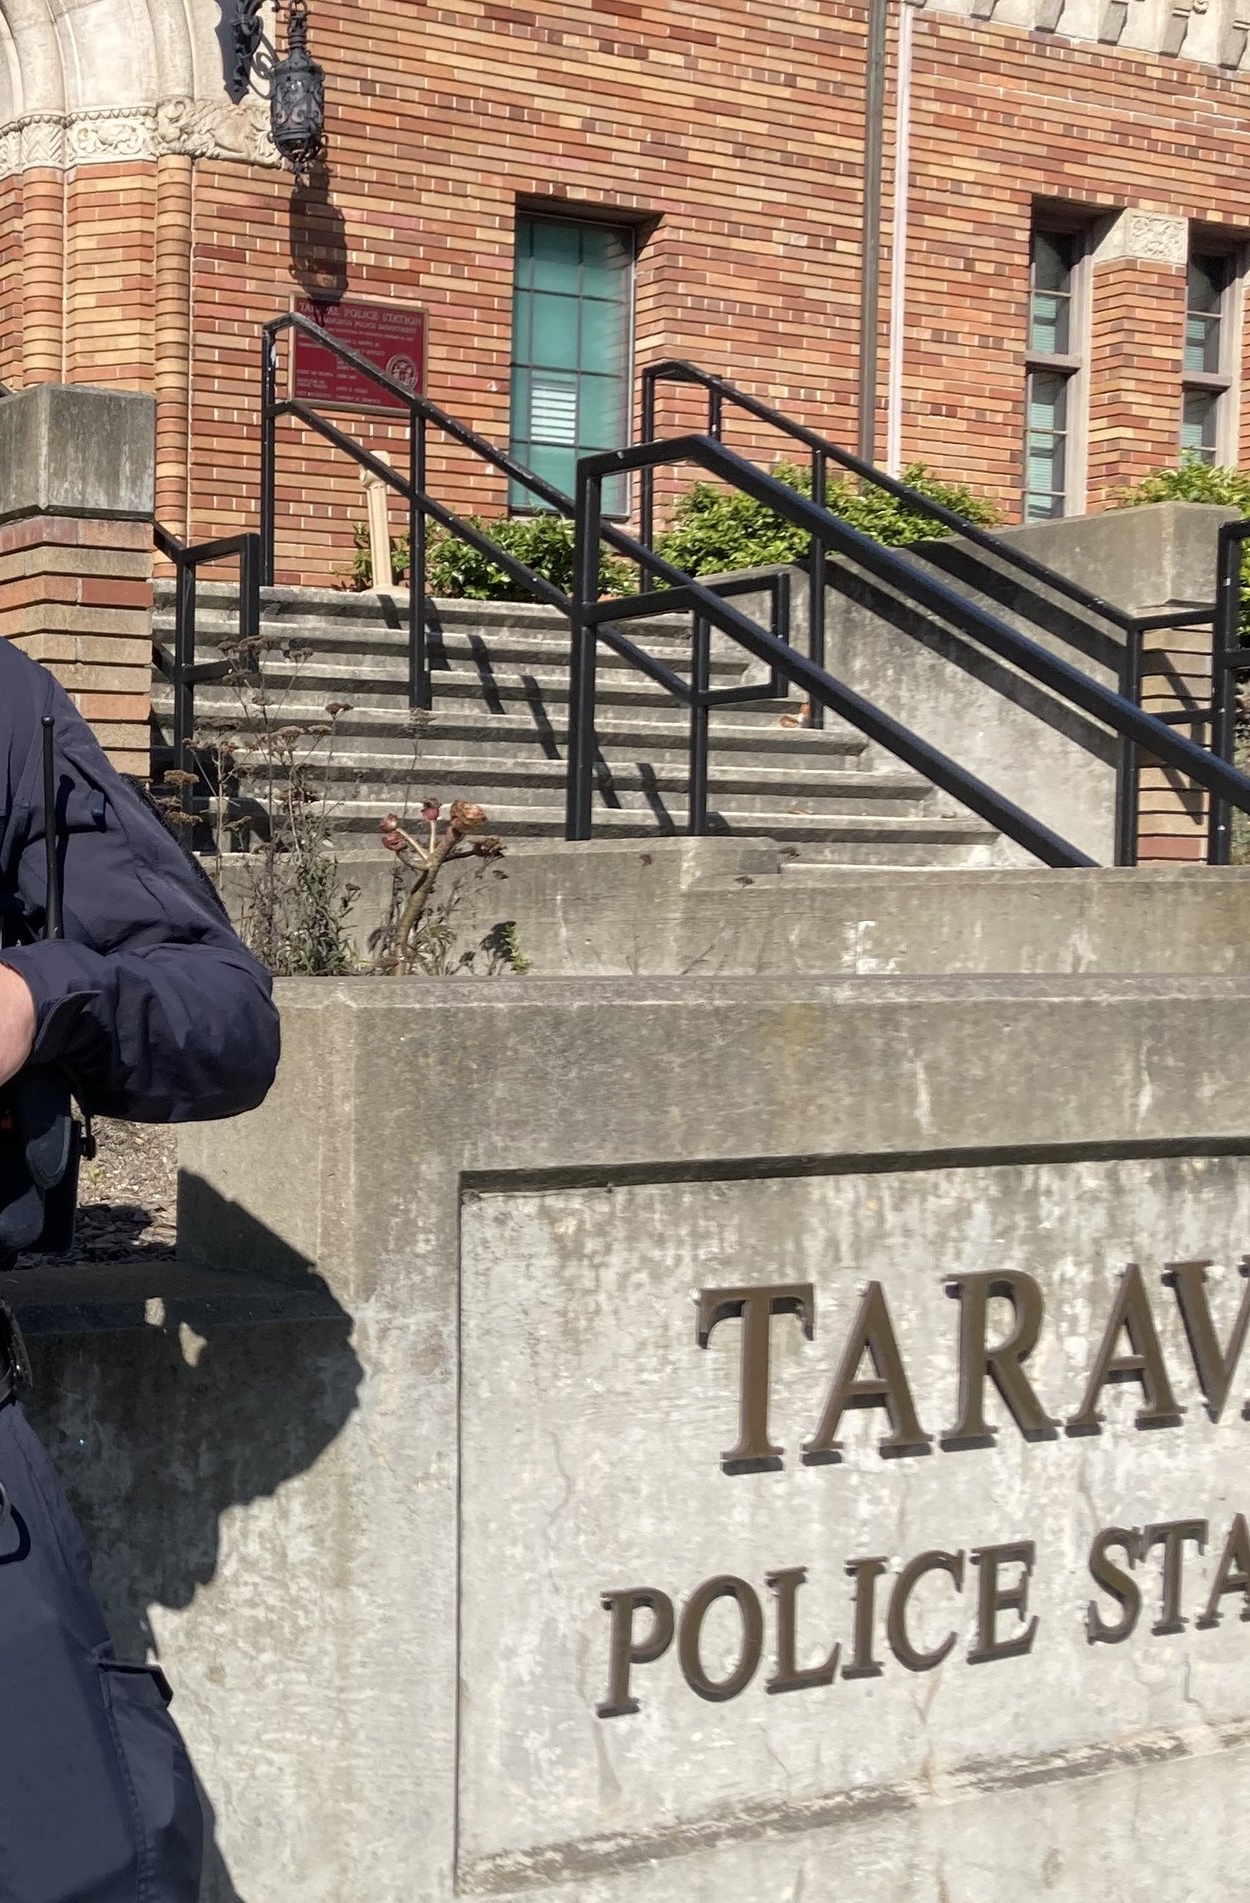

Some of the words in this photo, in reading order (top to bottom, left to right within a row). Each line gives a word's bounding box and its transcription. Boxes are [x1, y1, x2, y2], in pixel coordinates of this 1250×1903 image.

[344, 308, 379, 320] POLICE
[382, 312, 422, 326] STATION
[693, 1254, 1250, 1476] TARAV
[596, 1540, 1038, 1718] POLICE
[1085, 1512, 1250, 1646] STA
